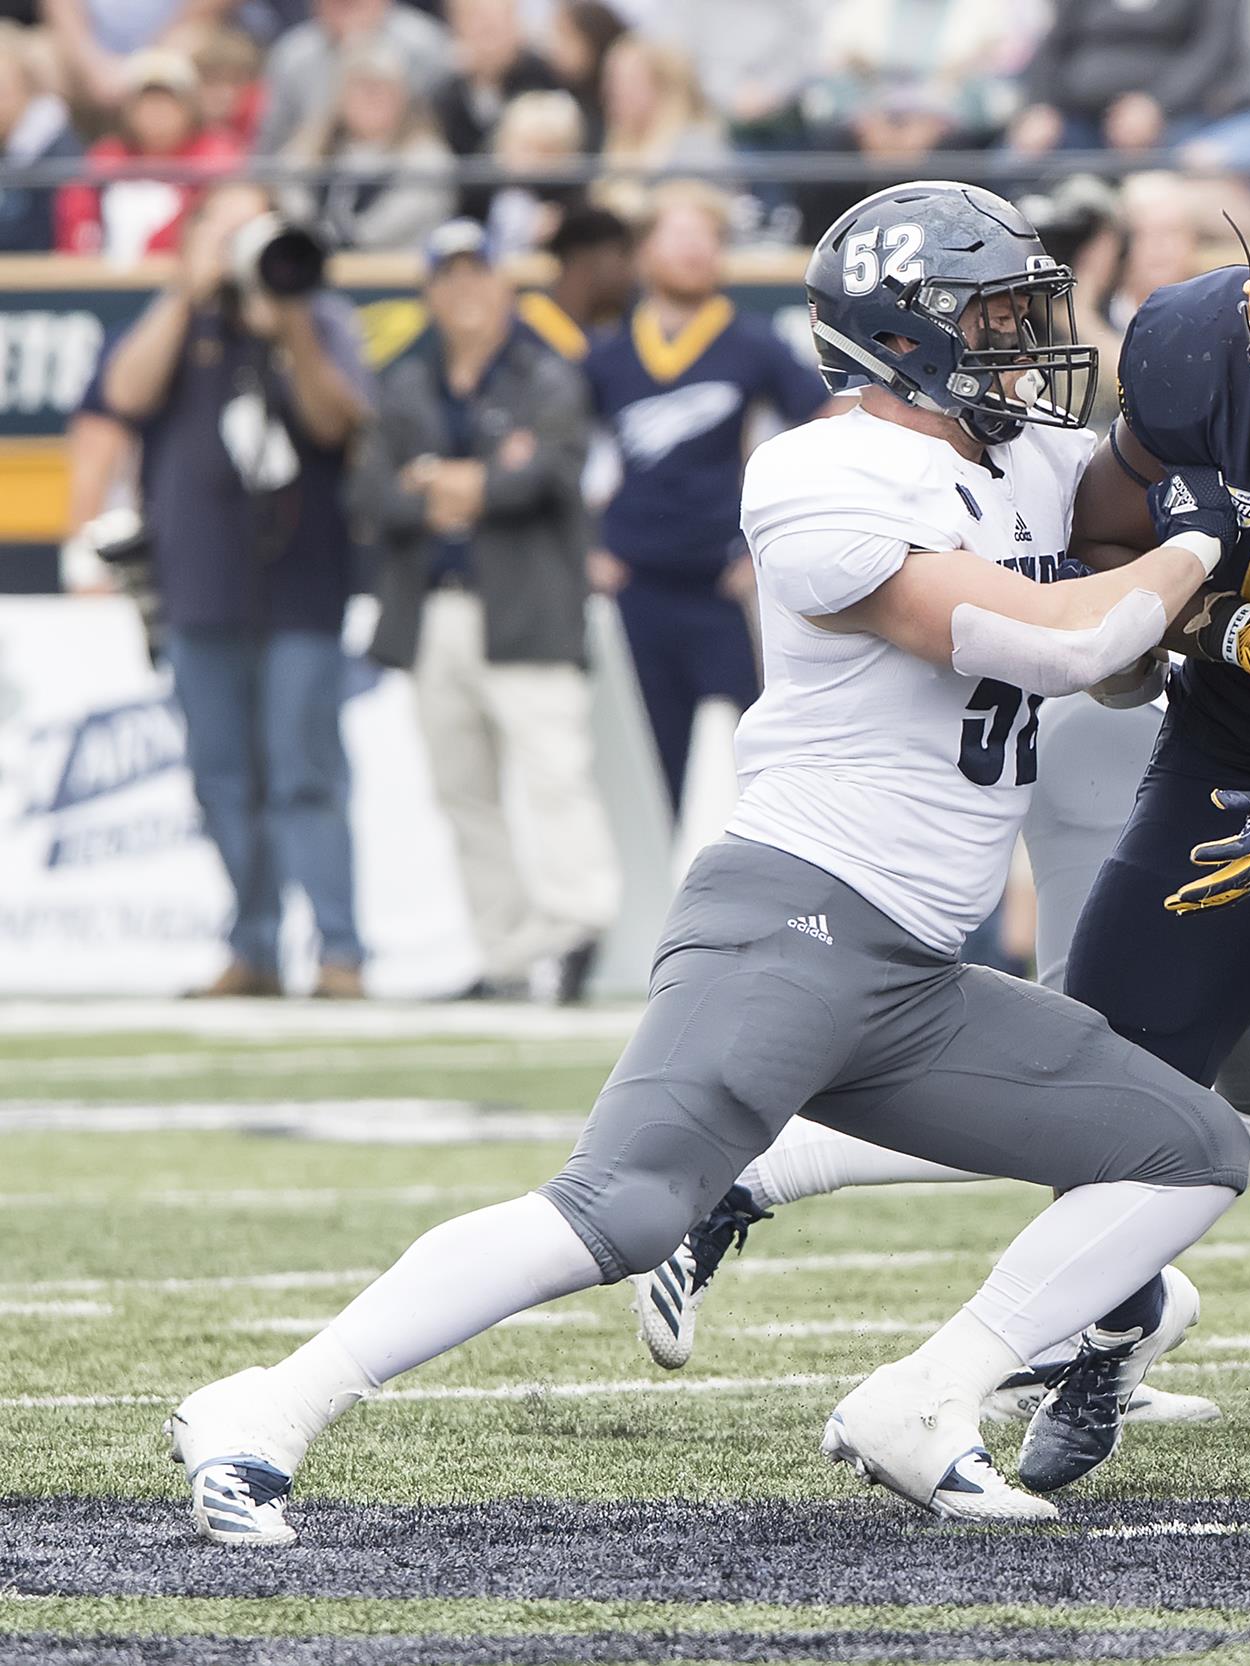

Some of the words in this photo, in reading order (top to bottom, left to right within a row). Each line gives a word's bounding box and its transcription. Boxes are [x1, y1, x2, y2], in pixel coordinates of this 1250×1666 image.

[843, 222, 924, 297] 52
[1226, 609, 1249, 653] BETTER
[786, 918, 834, 946] adidas
